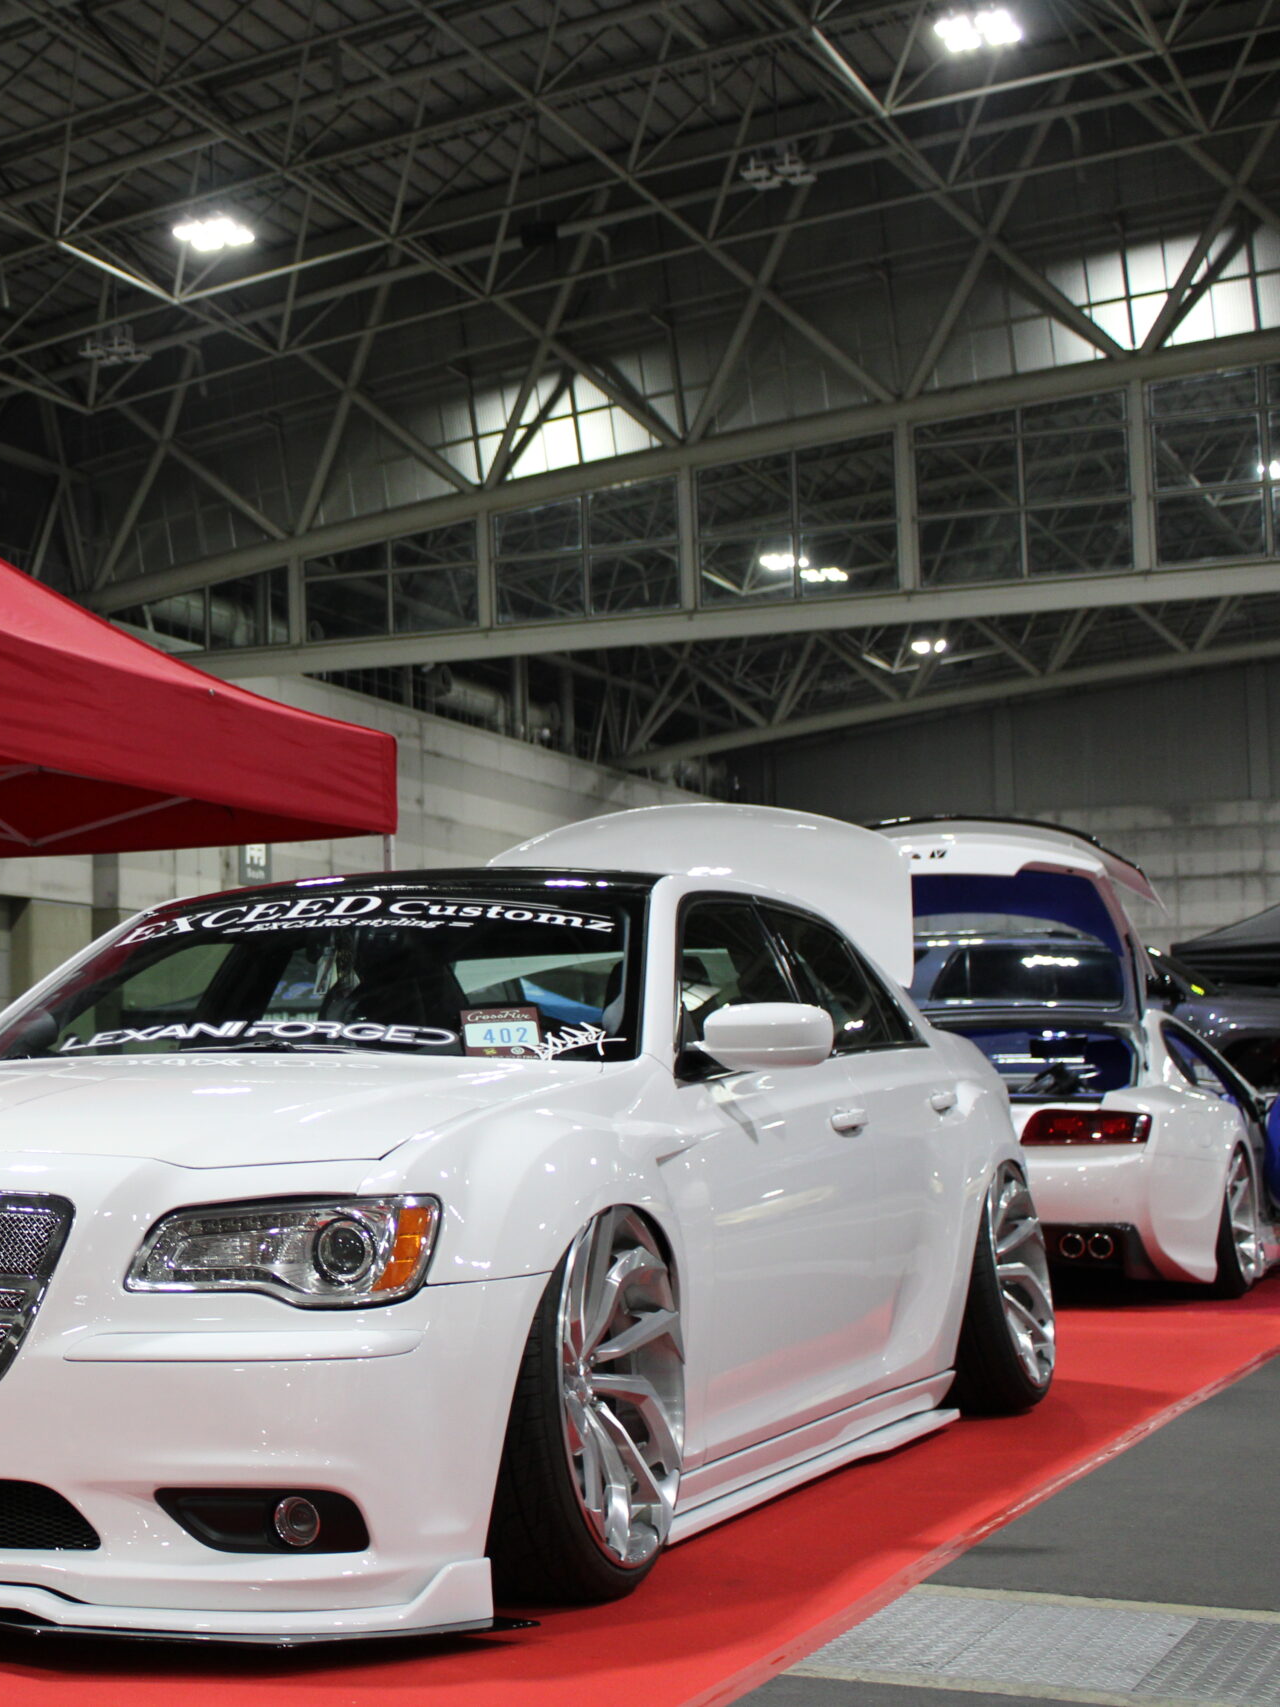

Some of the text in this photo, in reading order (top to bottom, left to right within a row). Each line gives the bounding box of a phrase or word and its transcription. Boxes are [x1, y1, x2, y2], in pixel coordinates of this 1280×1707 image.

[114, 895, 615, 948] EXCEED Customz
[244, 917, 445, 933] EXCARS styling
[59, 1020, 459, 1052] LEXANI FORGED
[483, 1026, 529, 1044] 402
